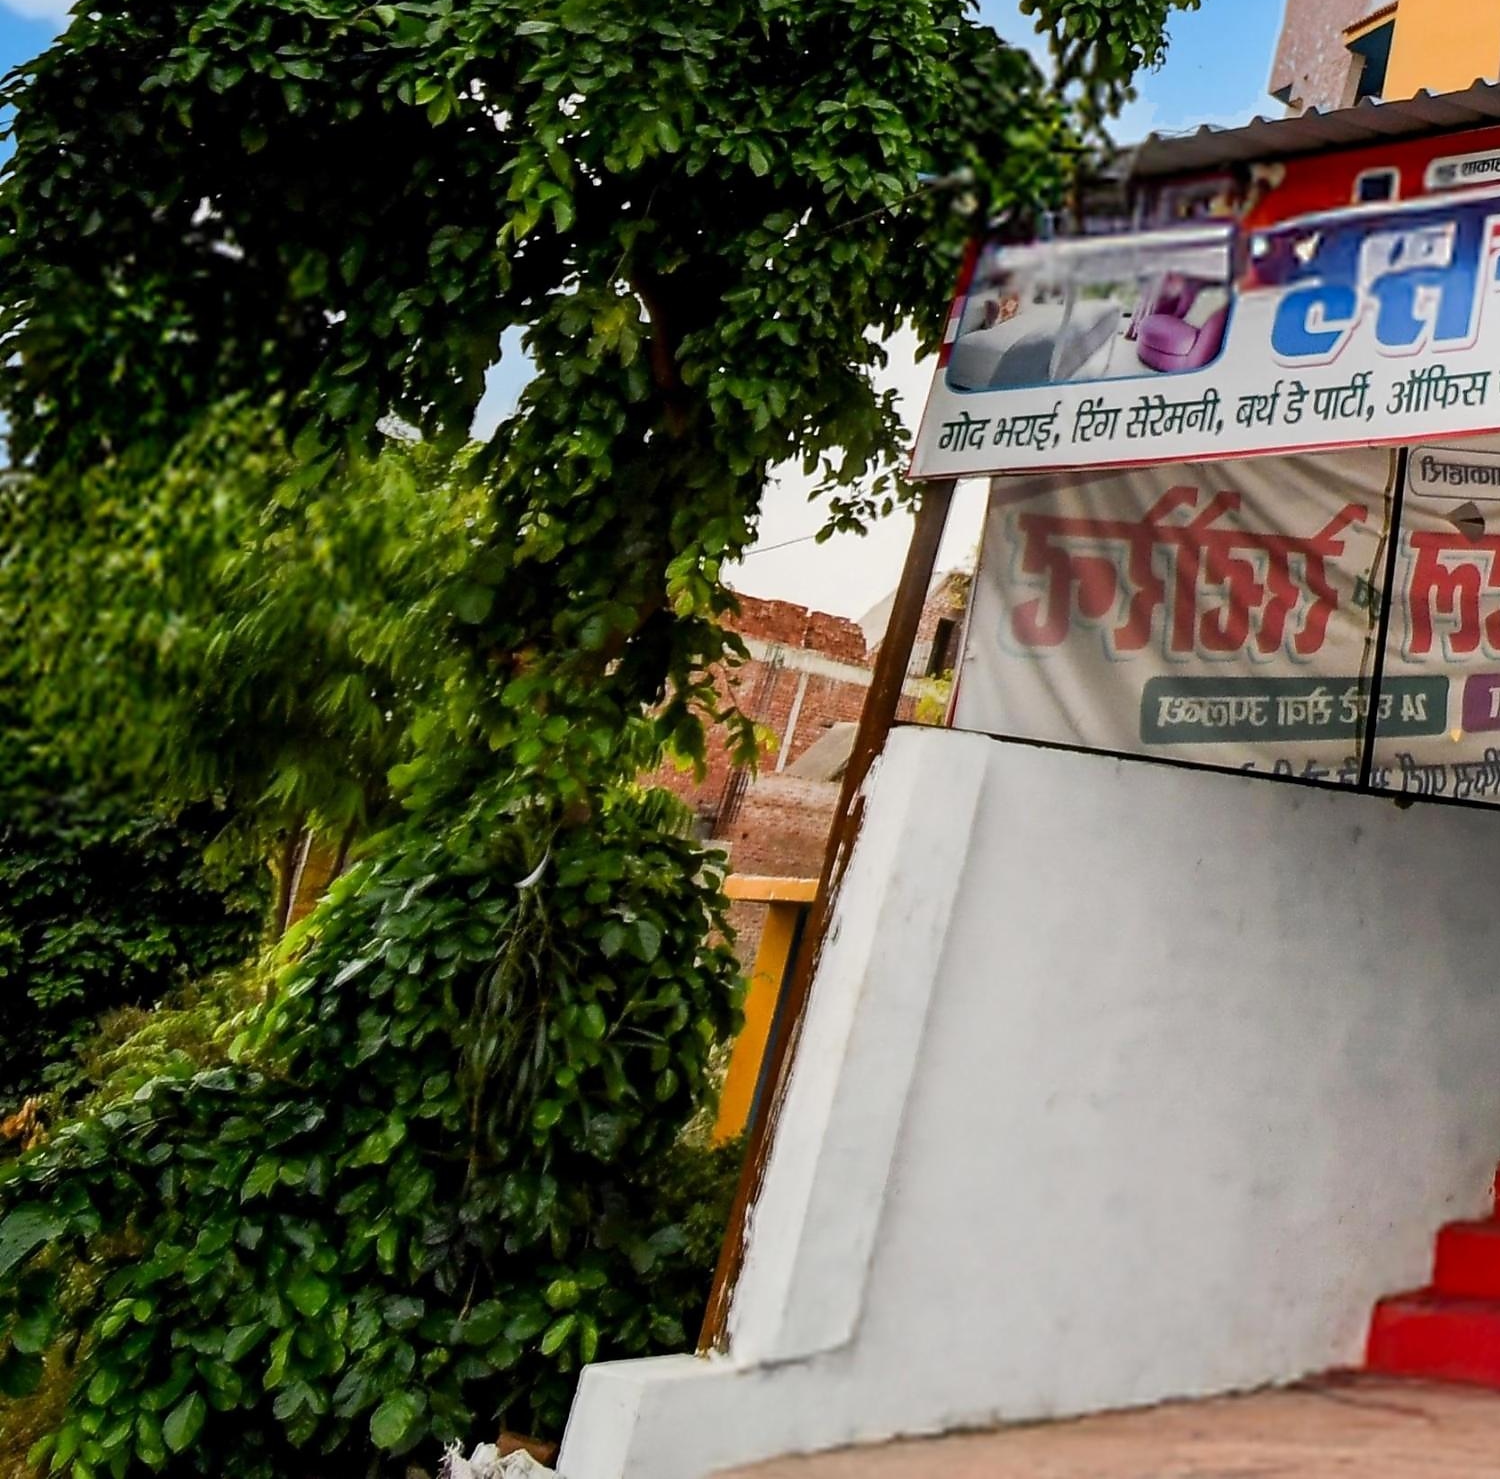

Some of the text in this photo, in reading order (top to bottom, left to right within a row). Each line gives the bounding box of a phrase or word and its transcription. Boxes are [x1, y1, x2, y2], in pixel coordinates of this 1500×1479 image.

[938, 410, 991, 452] गोद
[993, 399, 1061, 451] भराई,
[1071, 396, 1122, 444] रिंग
[1236, 379, 1282, 428] बर्थ
[1283, 379, 1309, 426] डे
[1312, 370, 1375, 423] पार्टी,
[1386, 362, 1490, 416] ऑफिस
